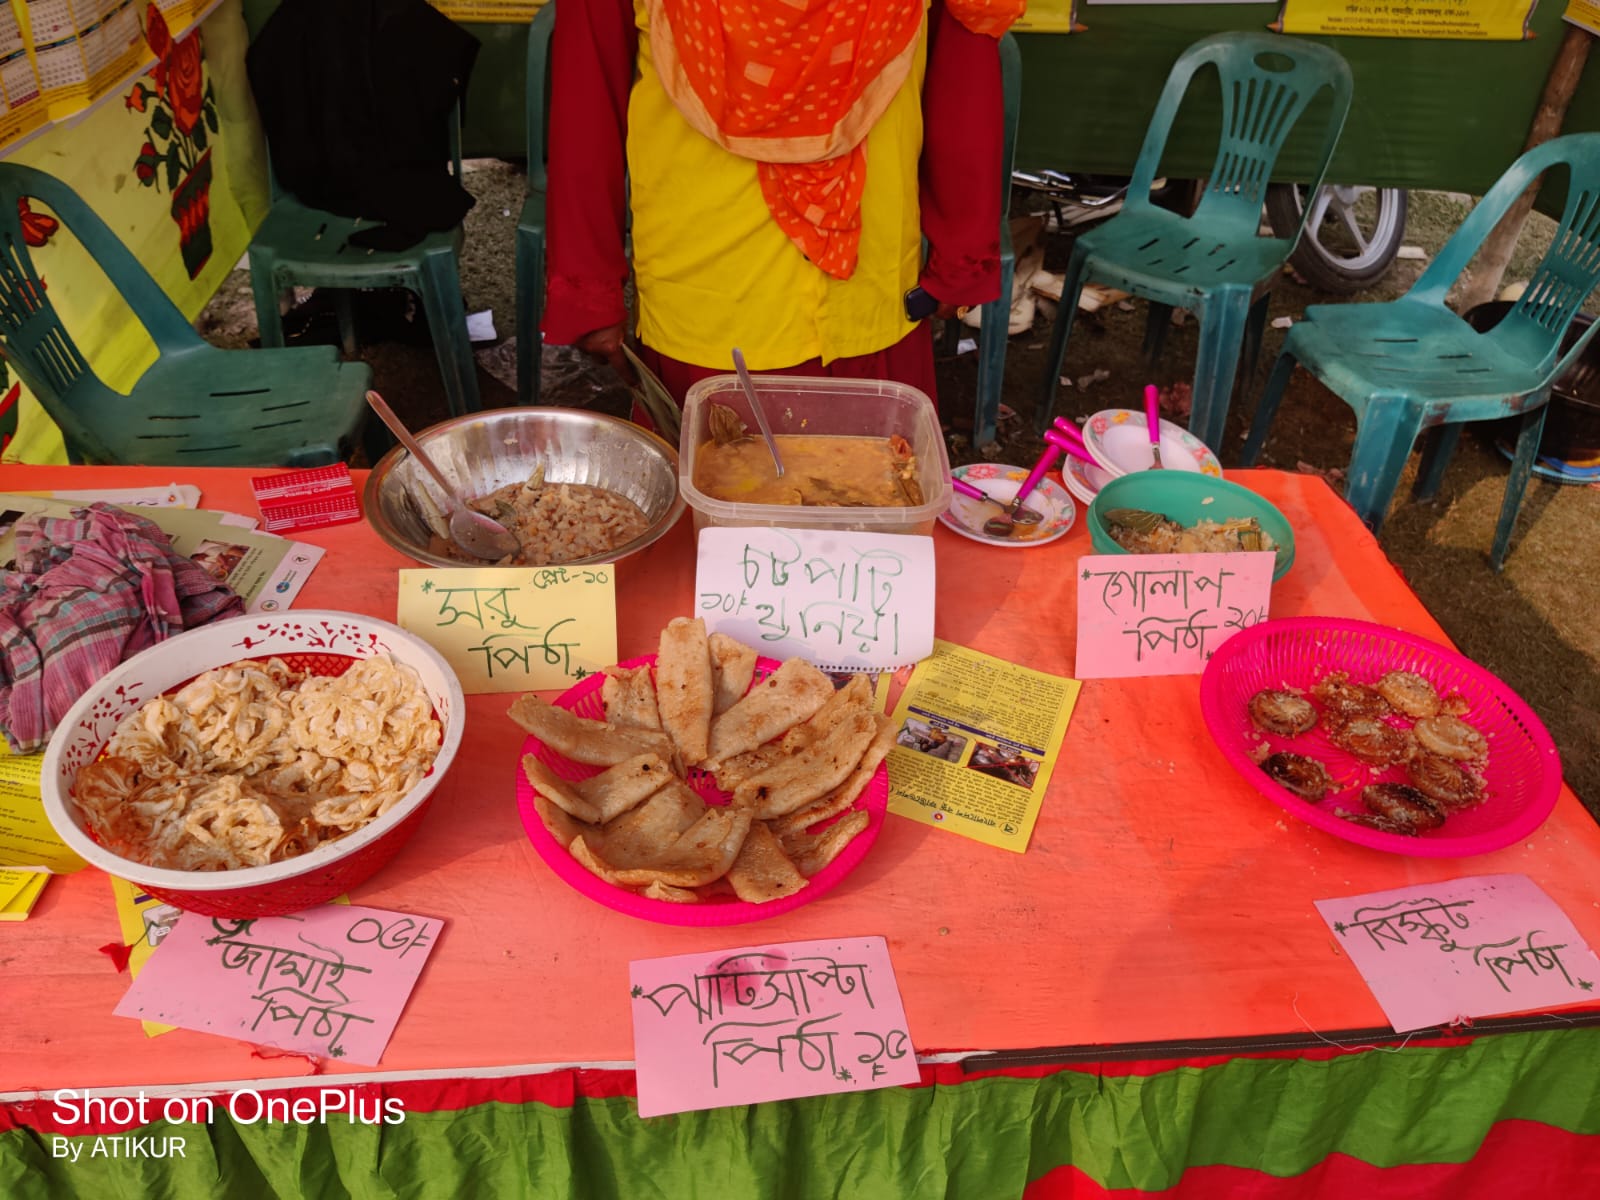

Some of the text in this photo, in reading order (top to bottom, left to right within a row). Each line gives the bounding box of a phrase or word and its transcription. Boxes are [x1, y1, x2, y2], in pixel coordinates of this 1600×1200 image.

[1094, 568, 1235, 615] গোলাপ
[468, 618, 581, 678] পিঠা
[1122, 608, 1218, 662] পিঠা
[218, 932, 373, 1004] জামাই
[1474, 930, 1569, 993] পিঠা
[251, 986, 374, 1053] পিঠা
[703, 1012, 843, 1089] পিঠা
